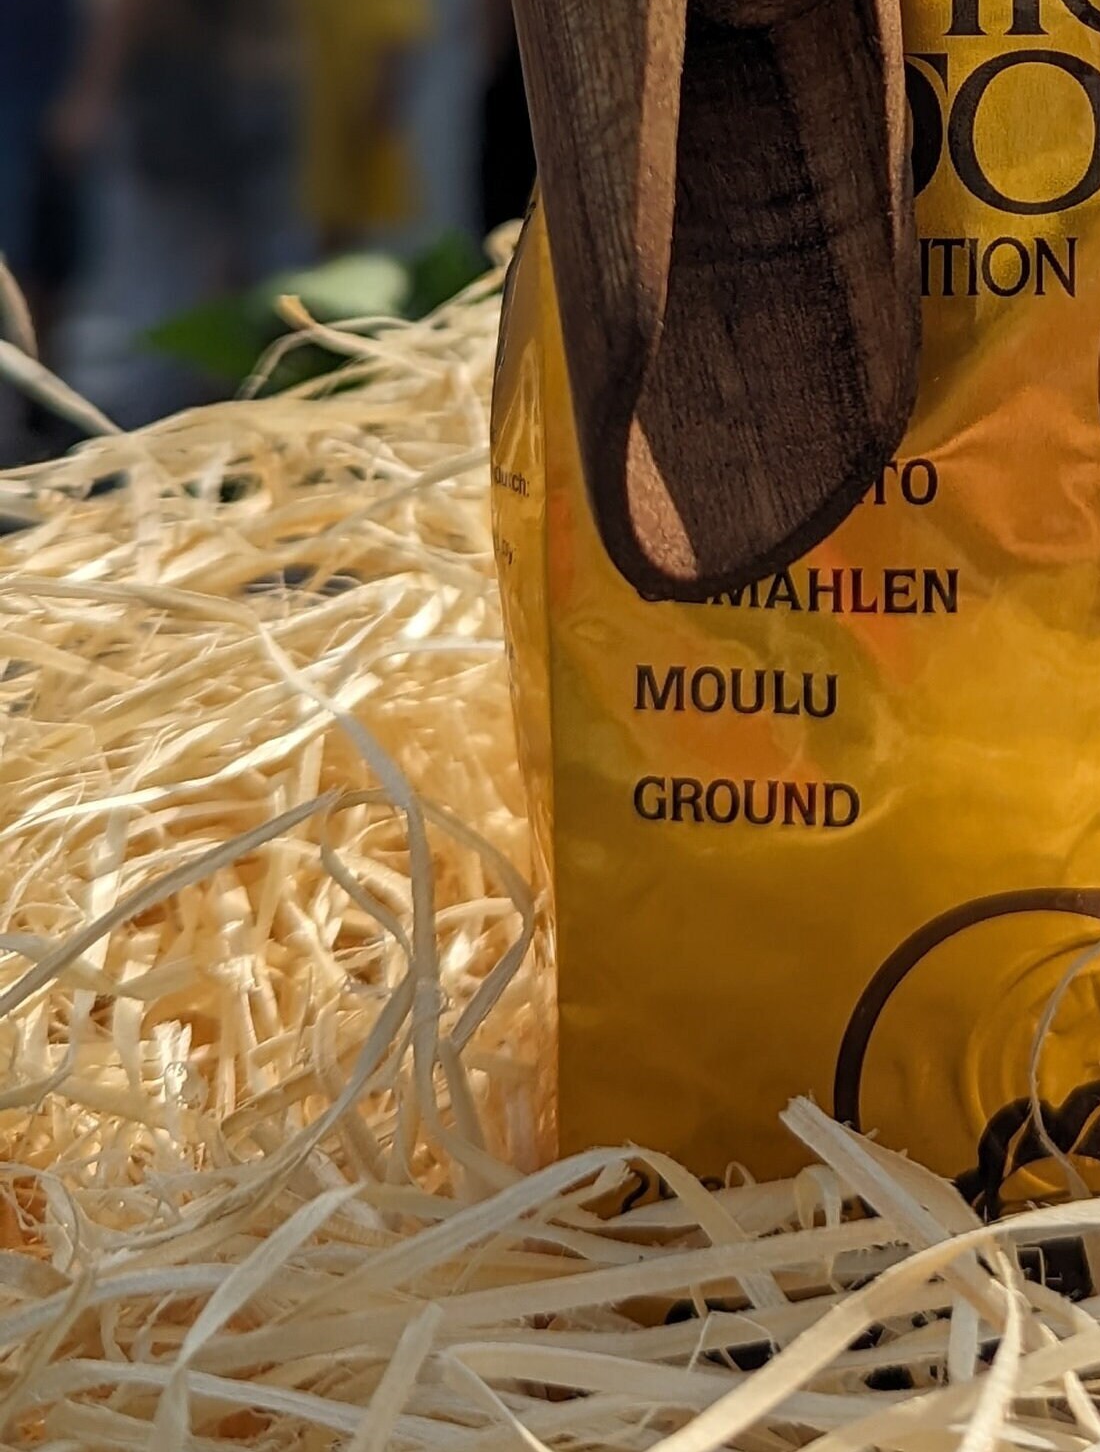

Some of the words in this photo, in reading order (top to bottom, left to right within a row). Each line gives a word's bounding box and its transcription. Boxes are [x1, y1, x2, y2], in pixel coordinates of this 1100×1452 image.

[920, 236, 1078, 297] ITION
[634, 665, 838, 718] MOULU
[633, 776, 860, 828] GROUND
